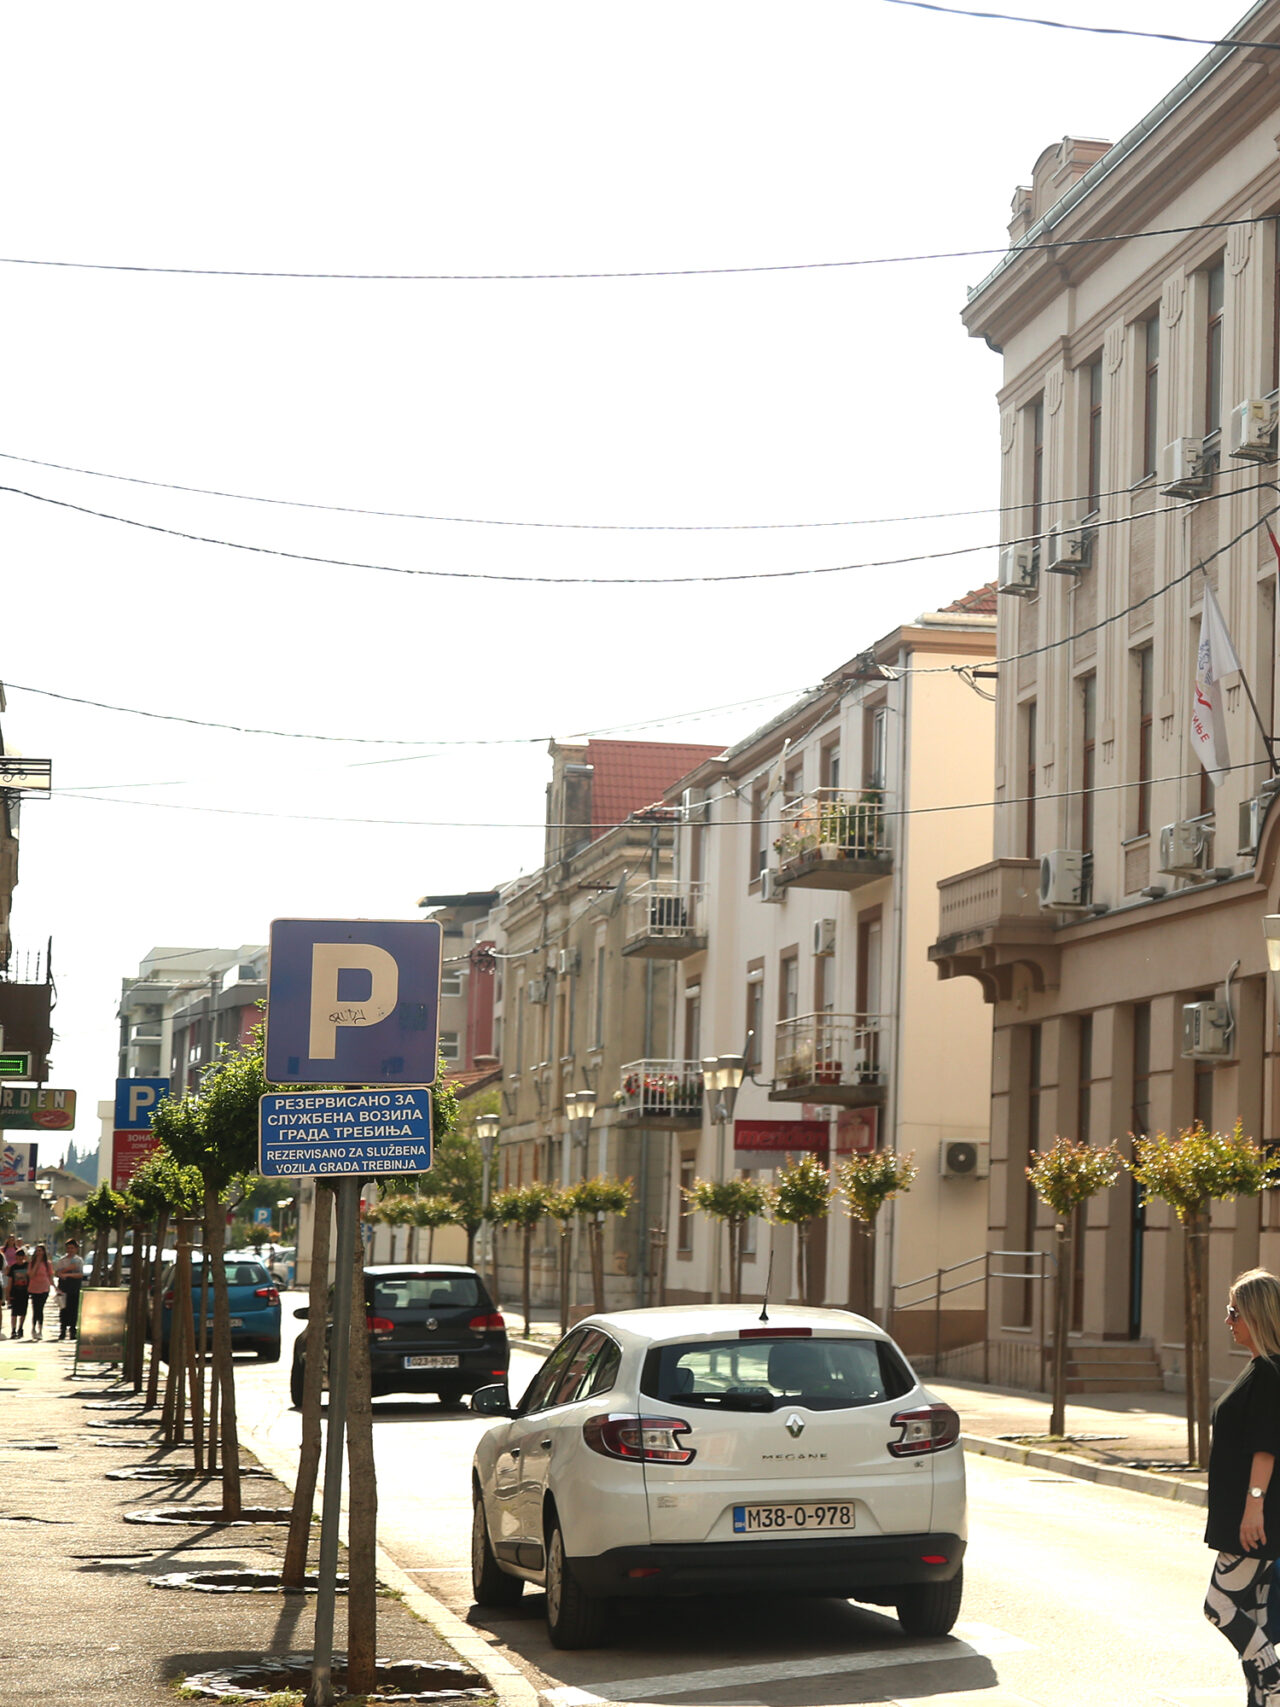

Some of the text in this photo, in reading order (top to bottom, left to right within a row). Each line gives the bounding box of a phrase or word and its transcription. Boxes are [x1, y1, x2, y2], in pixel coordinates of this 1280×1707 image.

[308, 943, 398, 1059] P
[0, 1089, 65, 1108] RDEN
[129, 1085, 155, 1121] P
[275, 1094, 415, 1110] РЕЗЕРВИСАНО ЗА
[267, 1109, 423, 1126] СЛУЖБЕНА ВОЗИЛА
[279, 1124, 412, 1141] ГРАДА ТРЕБИЊА
[266, 1143, 426, 1160] REZERVISANO ZA SLUŽBENA
[276, 1159, 417, 1174] VOZILA GRADA TREBINJA
[258, 1210, 268, 1223] P
